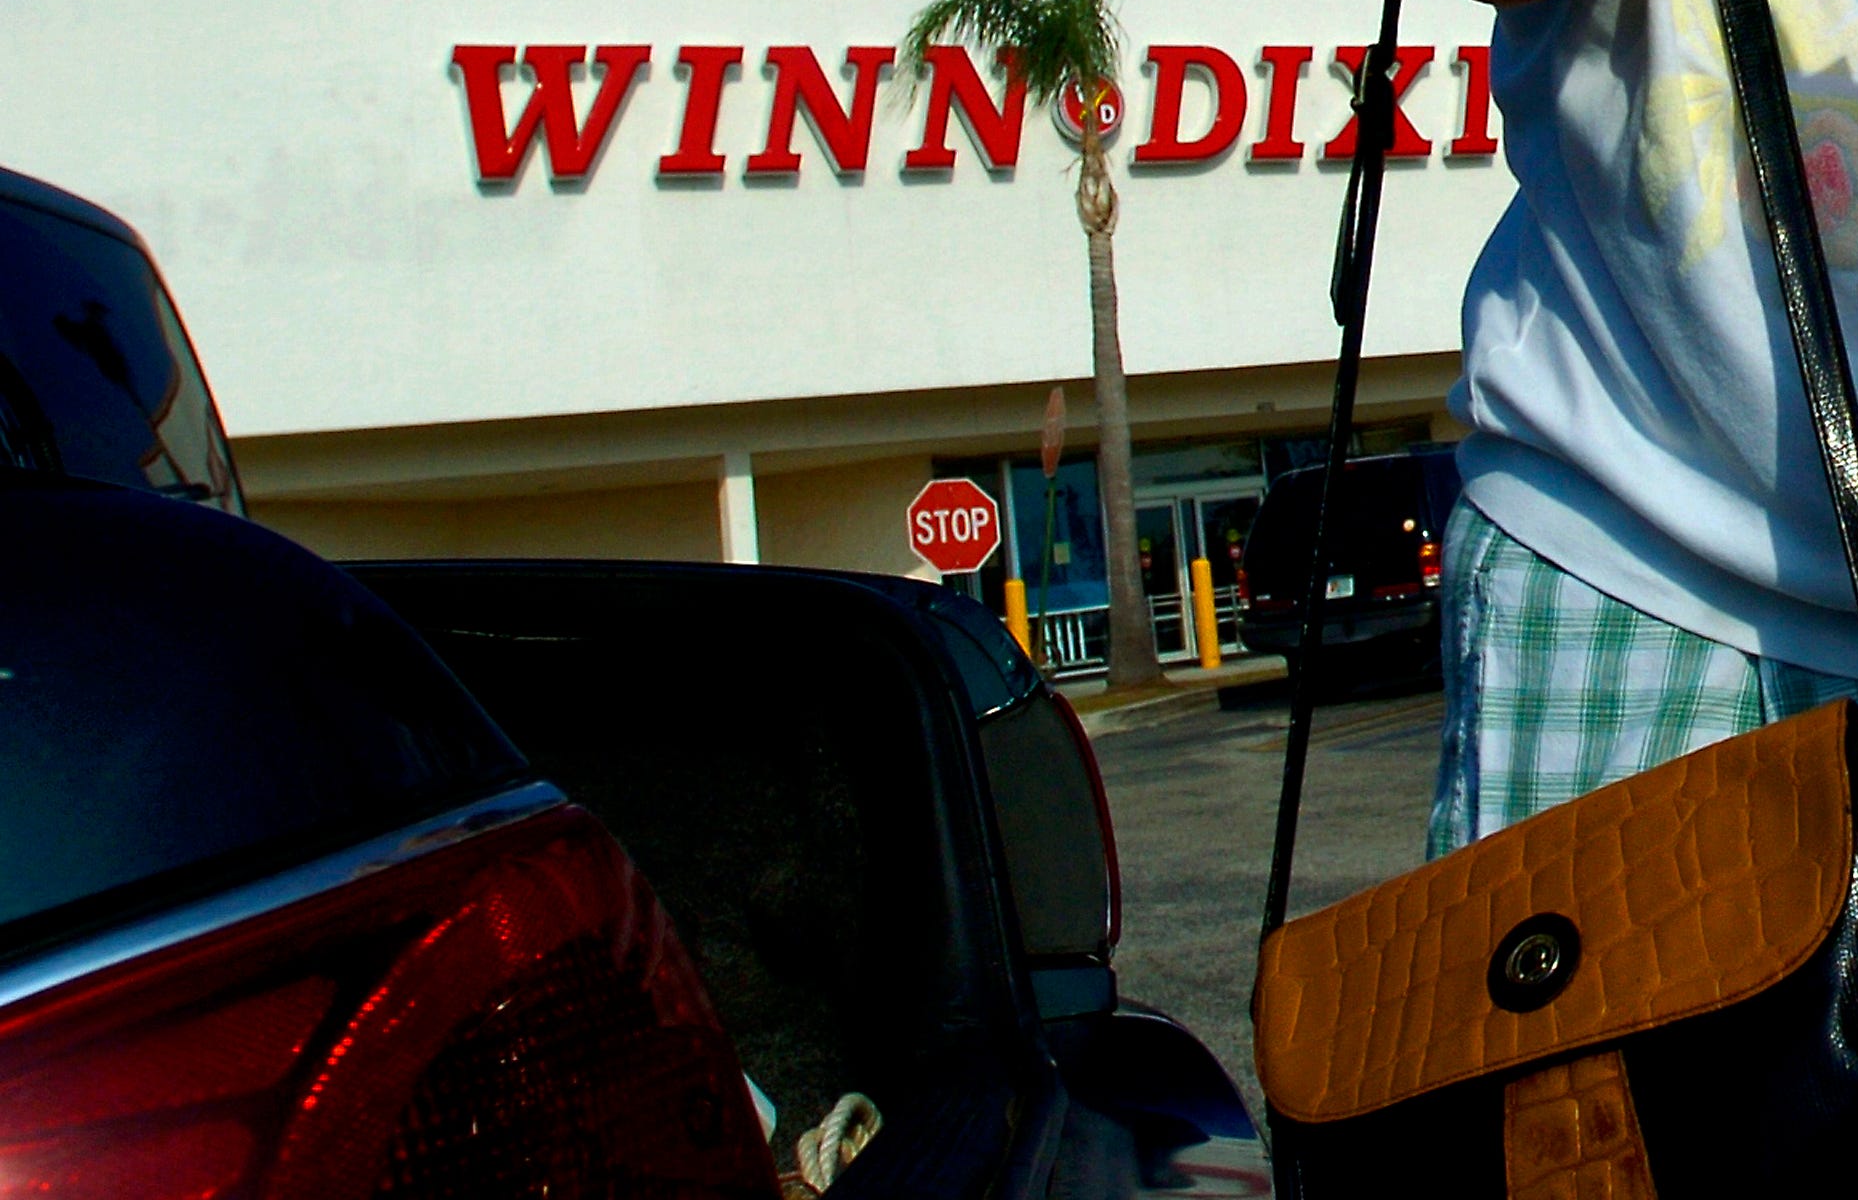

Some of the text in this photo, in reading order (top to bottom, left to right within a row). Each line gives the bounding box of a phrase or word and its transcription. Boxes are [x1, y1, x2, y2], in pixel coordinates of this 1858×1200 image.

[449, 44, 1030, 182] WINN
[1129, 45, 1498, 164] DIXI
[915, 506, 990, 545] STOP
